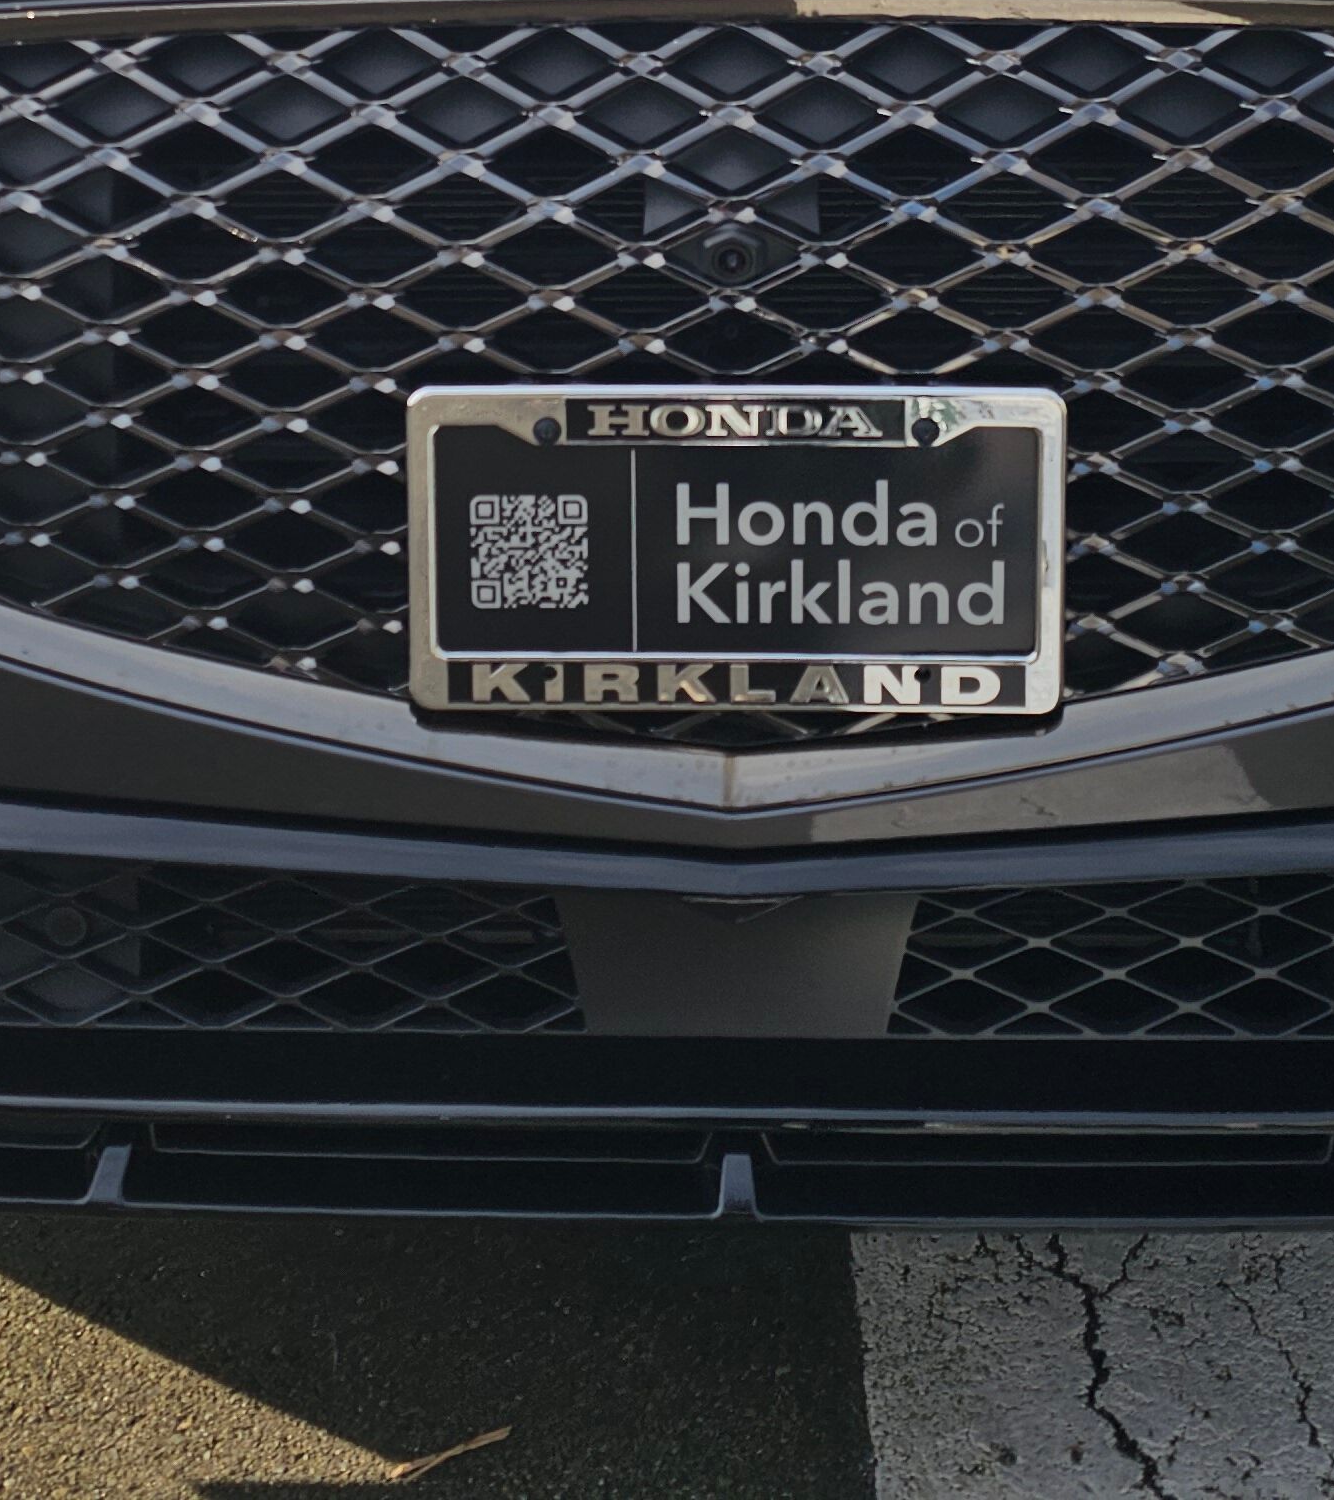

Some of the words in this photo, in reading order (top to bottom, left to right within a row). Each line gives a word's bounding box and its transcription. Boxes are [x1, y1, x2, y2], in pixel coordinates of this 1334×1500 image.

[587, 404, 884, 438] HONDA
[676, 479, 938, 547] Honda
[954, 503, 1005, 548] of
[676, 558, 1005, 626] Kirkland
[471, 663, 1002, 706] KIRKLAND
